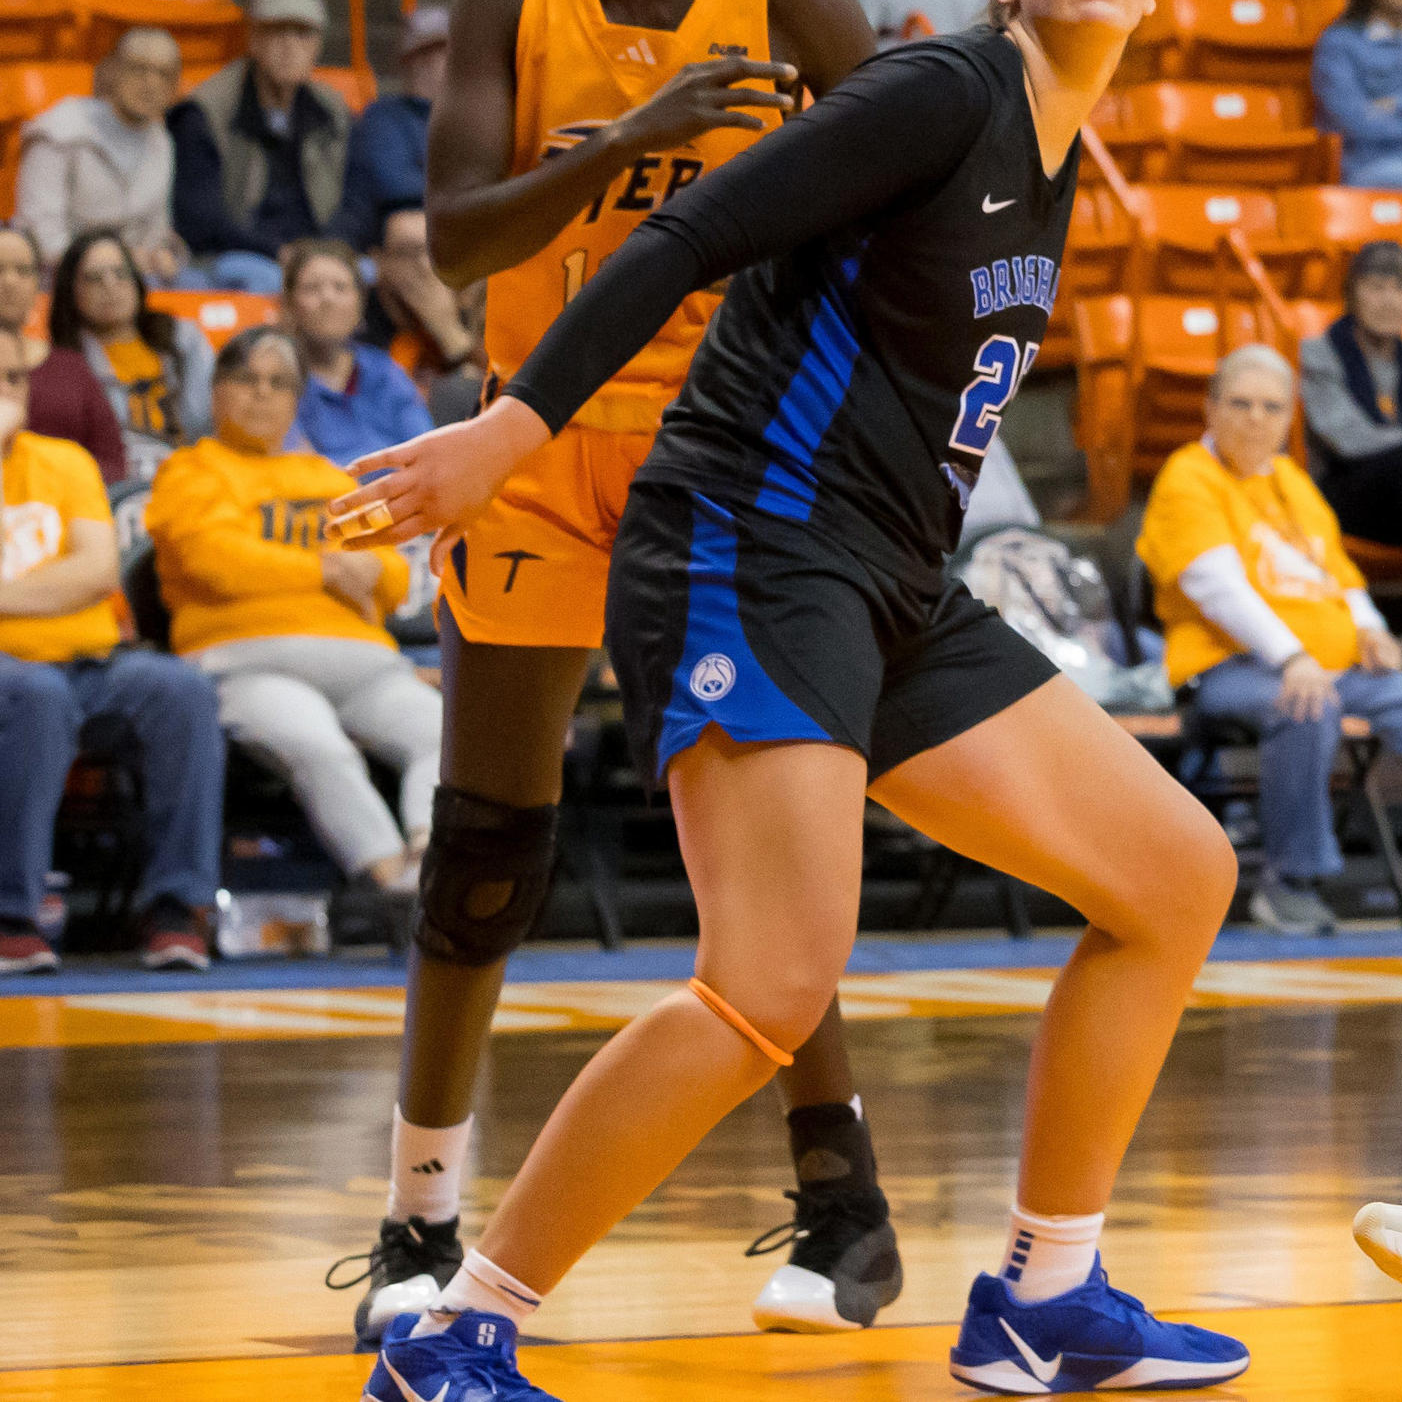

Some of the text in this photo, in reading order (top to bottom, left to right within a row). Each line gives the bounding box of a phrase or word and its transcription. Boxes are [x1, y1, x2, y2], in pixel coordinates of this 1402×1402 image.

[562, 248, 594, 311] 1
[970, 254, 1061, 319] BRIGH
[948, 333, 1041, 458] 2
